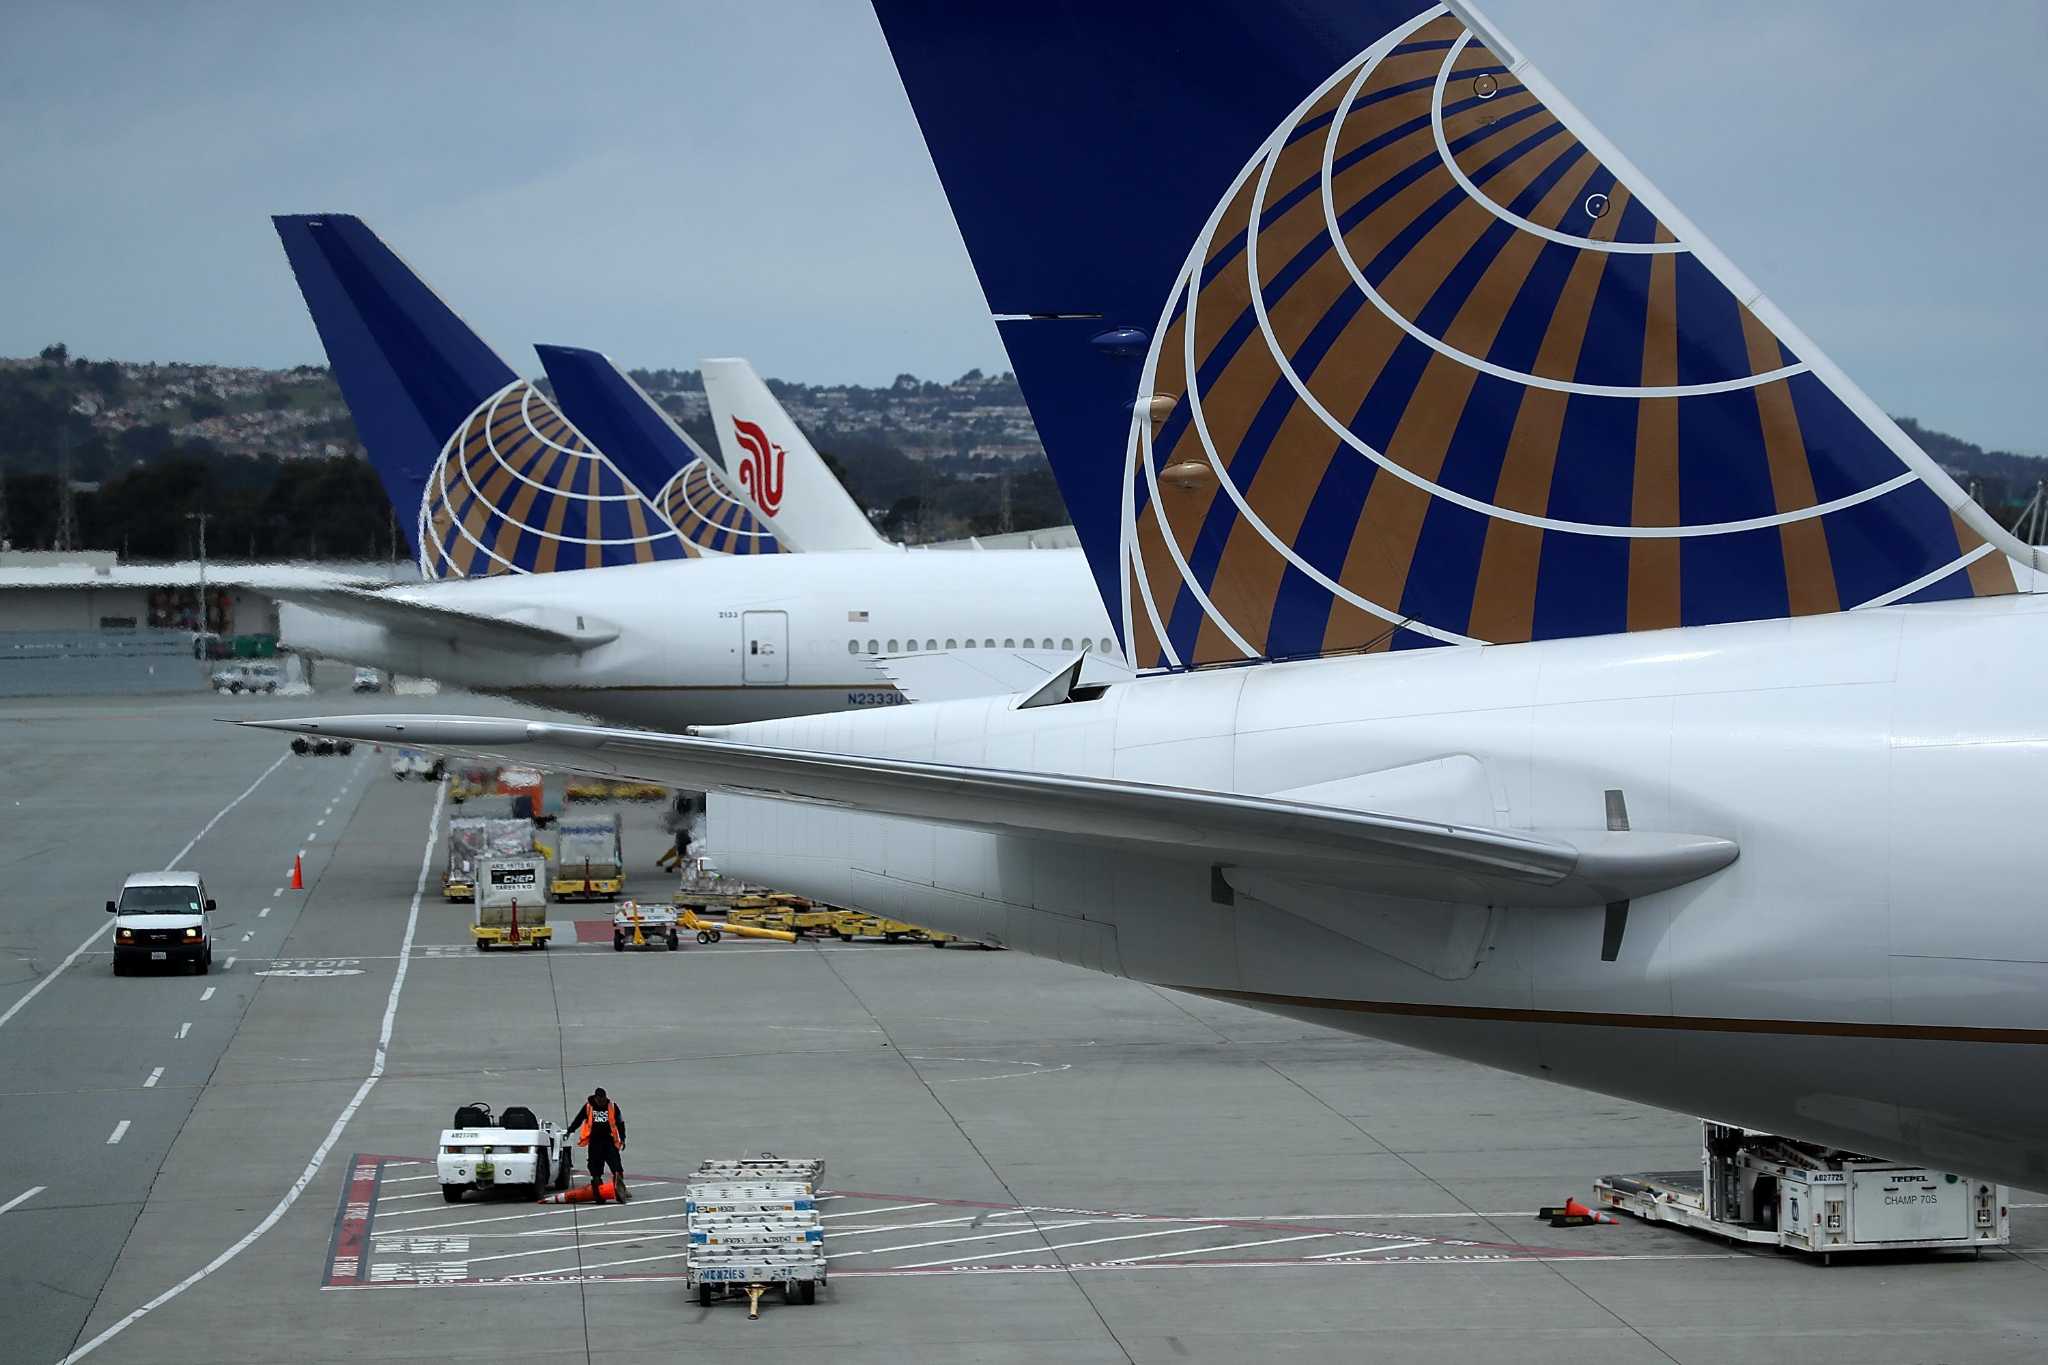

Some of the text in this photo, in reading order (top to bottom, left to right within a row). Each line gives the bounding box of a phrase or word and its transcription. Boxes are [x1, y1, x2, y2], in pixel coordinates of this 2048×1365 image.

[503, 874, 534, 883] CHEP
[270, 960, 361, 968] STOP
[1884, 1194, 1938, 1205] CHAMP 70S
[479, 1275, 605, 1283] PARKING
